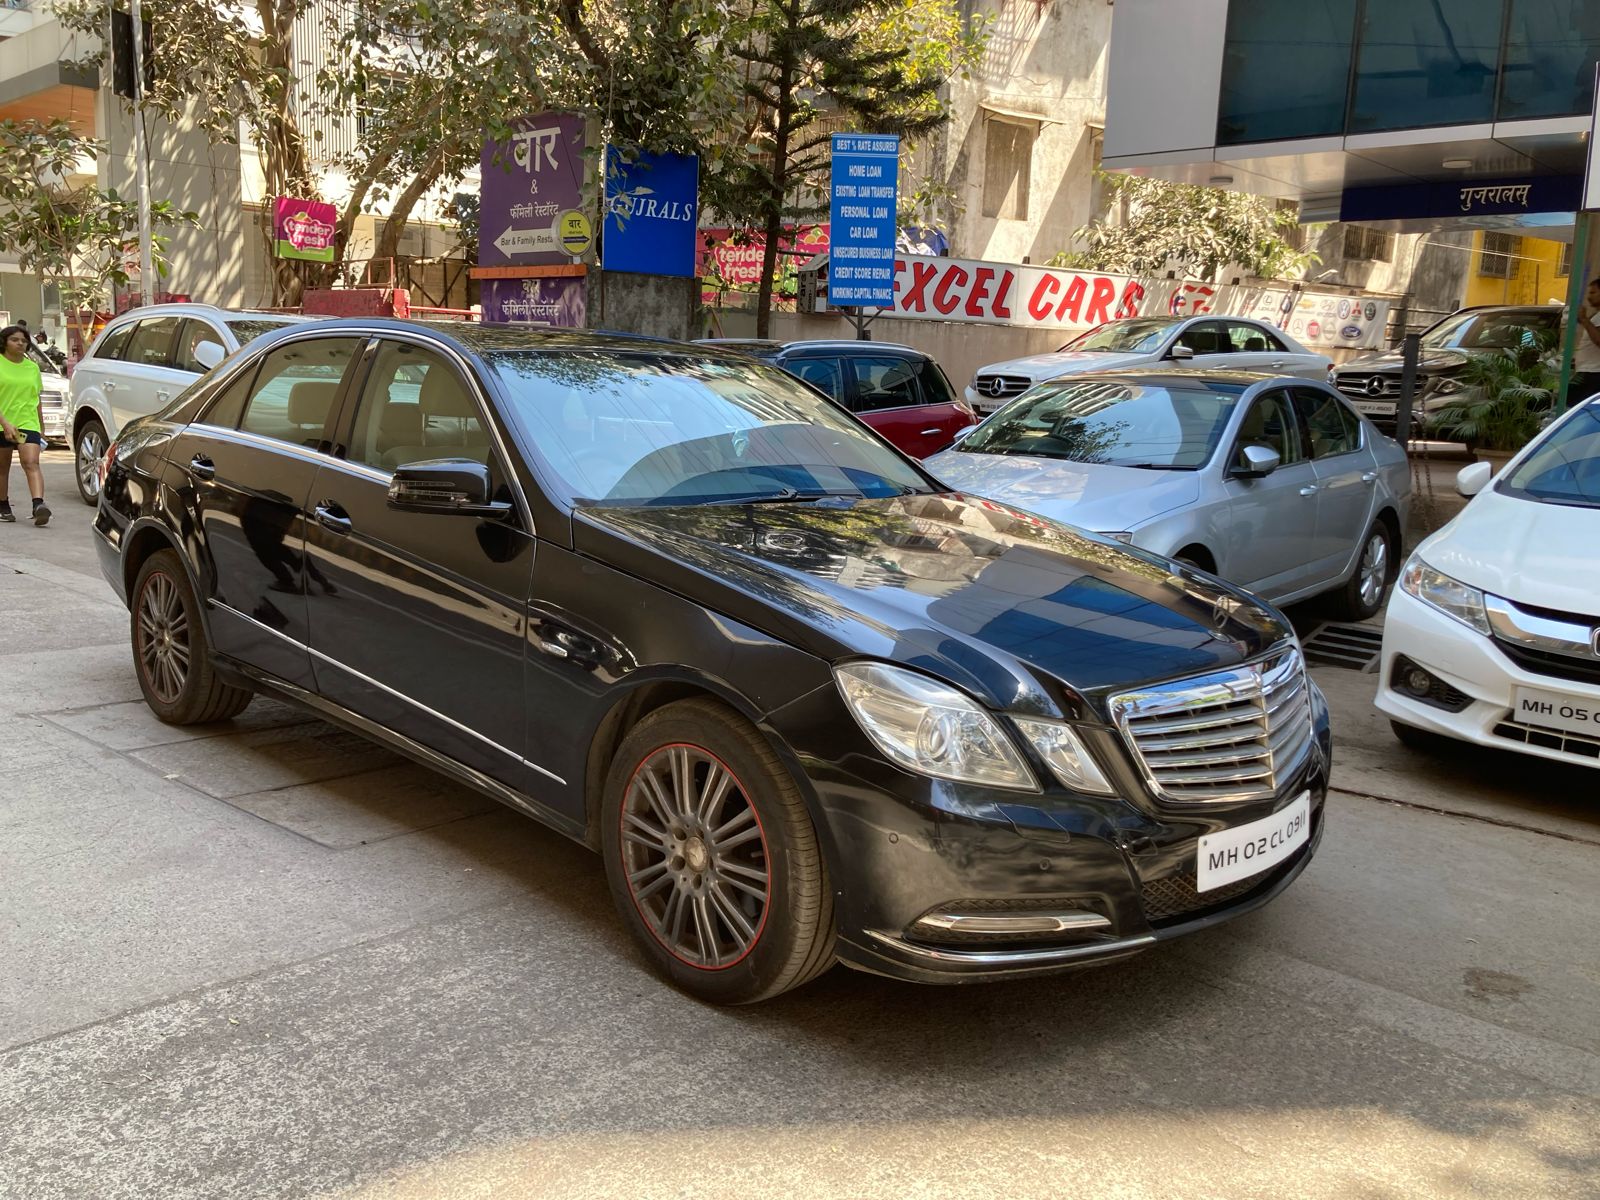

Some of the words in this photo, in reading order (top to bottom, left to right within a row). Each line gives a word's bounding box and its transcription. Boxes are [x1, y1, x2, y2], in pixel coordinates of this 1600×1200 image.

[837, 139, 851, 151] BEST
[857, 140, 871, 151] RATE
[872, 141, 897, 152] ASSURED
[849, 165, 866, 177] HOME
[866, 165, 882, 178] LOAN
[530, 179, 538, 194] &
[835, 185, 857, 197] EXISTING
[858, 186, 871, 198] LOAN
[871, 186, 894, 199] TRANSFER
[610, 195, 693, 221] GUJRALS
[840, 206, 870, 218] PERSONAL
[872, 207, 888, 219] LOAN
[850, 226, 862, 238] CAR
[862, 227, 878, 239] LOAN
[501, 238, 511, 246] Bar
[517, 236, 536, 246] Family
[537, 235, 554, 244] Resta
[719, 245, 765, 262] tende
[833, 246, 858, 259] UNSECURED
[881, 248, 893, 260] LOAN
[834, 267, 853, 279] CREDIT
[854, 267, 872, 279] SCORE
[872, 268, 891, 280] REPAIR
[832, 286, 853, 298] WORKING
[854, 287, 872, 299] CAPITAL
[872, 288, 892, 300] FINANCE
[1028, 273, 1145, 324] CARS
[1522, 699, 1553, 715] MH
[1559, 706, 1588, 720] 05
[1209, 847, 1238, 870] MH
[1244, 838, 1266, 859] 02
[1270, 829, 1285, 848] CL
[1286, 810, 1306, 838] 0911
